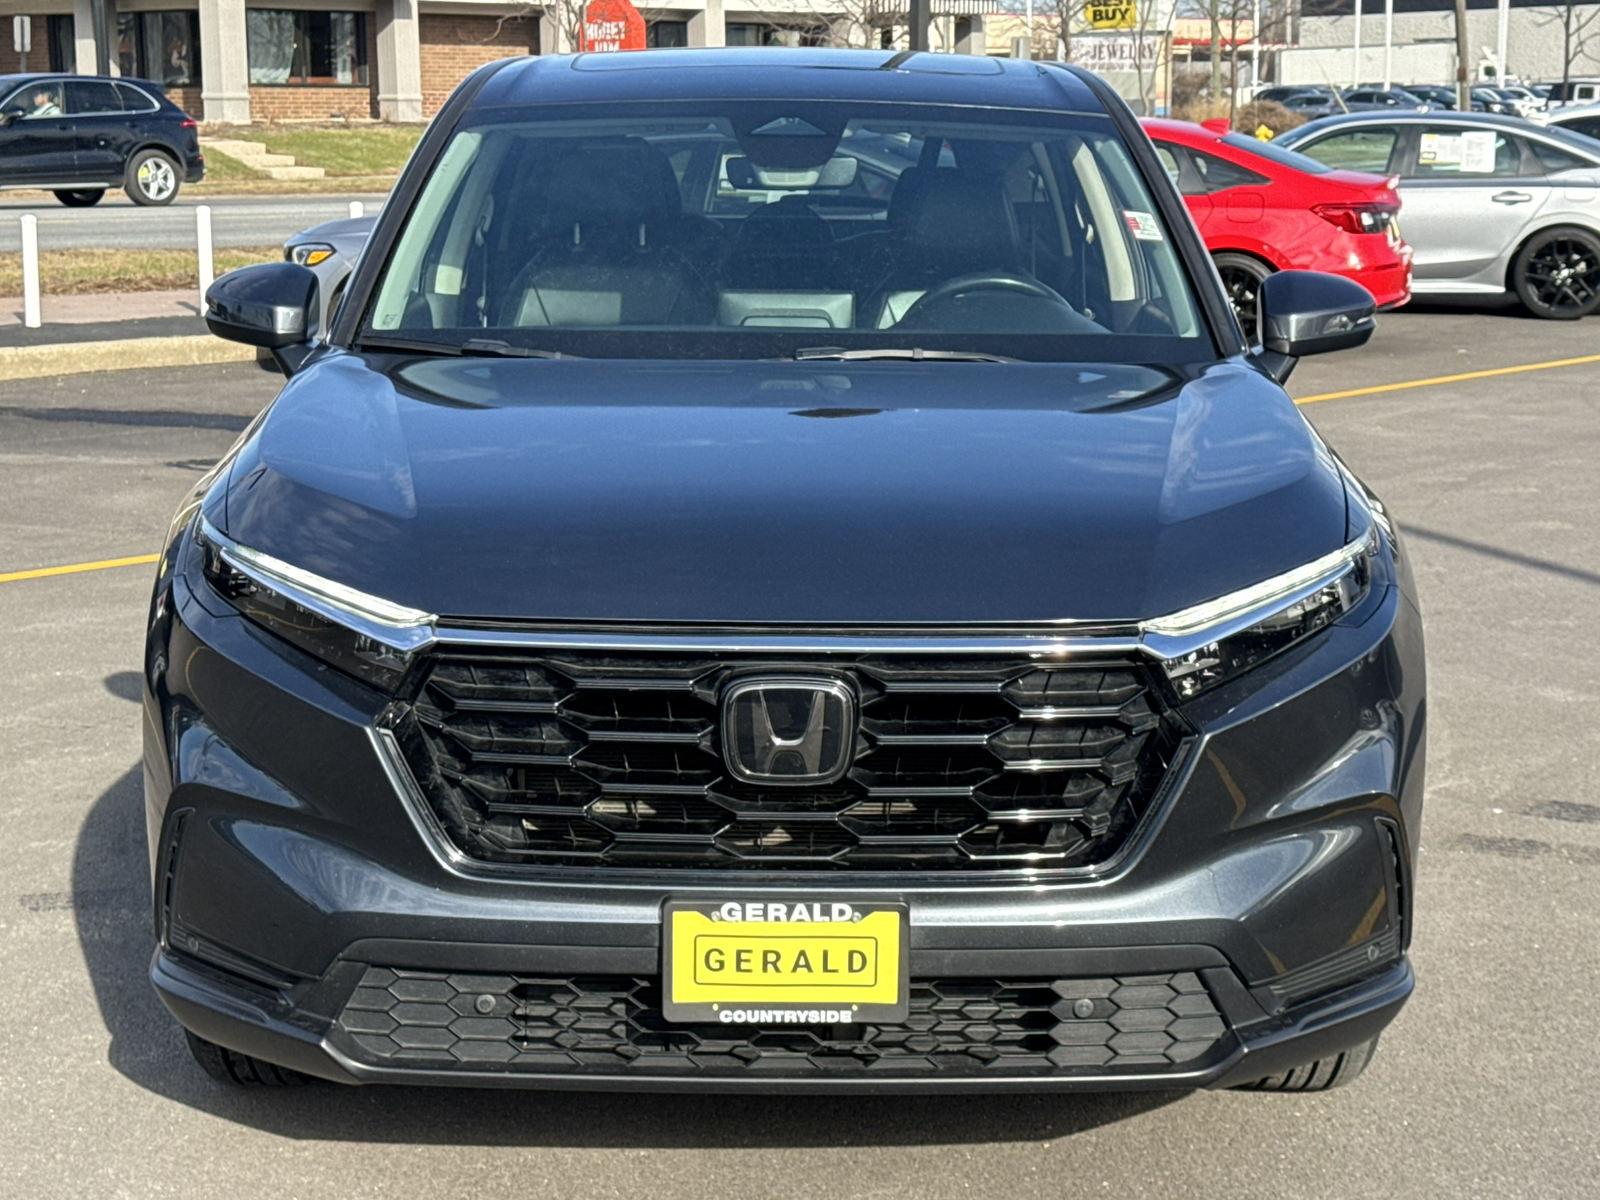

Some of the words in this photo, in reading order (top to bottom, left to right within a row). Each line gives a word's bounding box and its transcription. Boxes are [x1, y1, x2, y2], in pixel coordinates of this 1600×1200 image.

[1092, 8, 1130, 21] BUY
[1090, 43, 1156, 60] JEWELRY
[720, 902, 853, 922] GERALD
[704, 948, 868, 973] GERALD
[719, 1009, 853, 1023] COUNTRYSIDE
